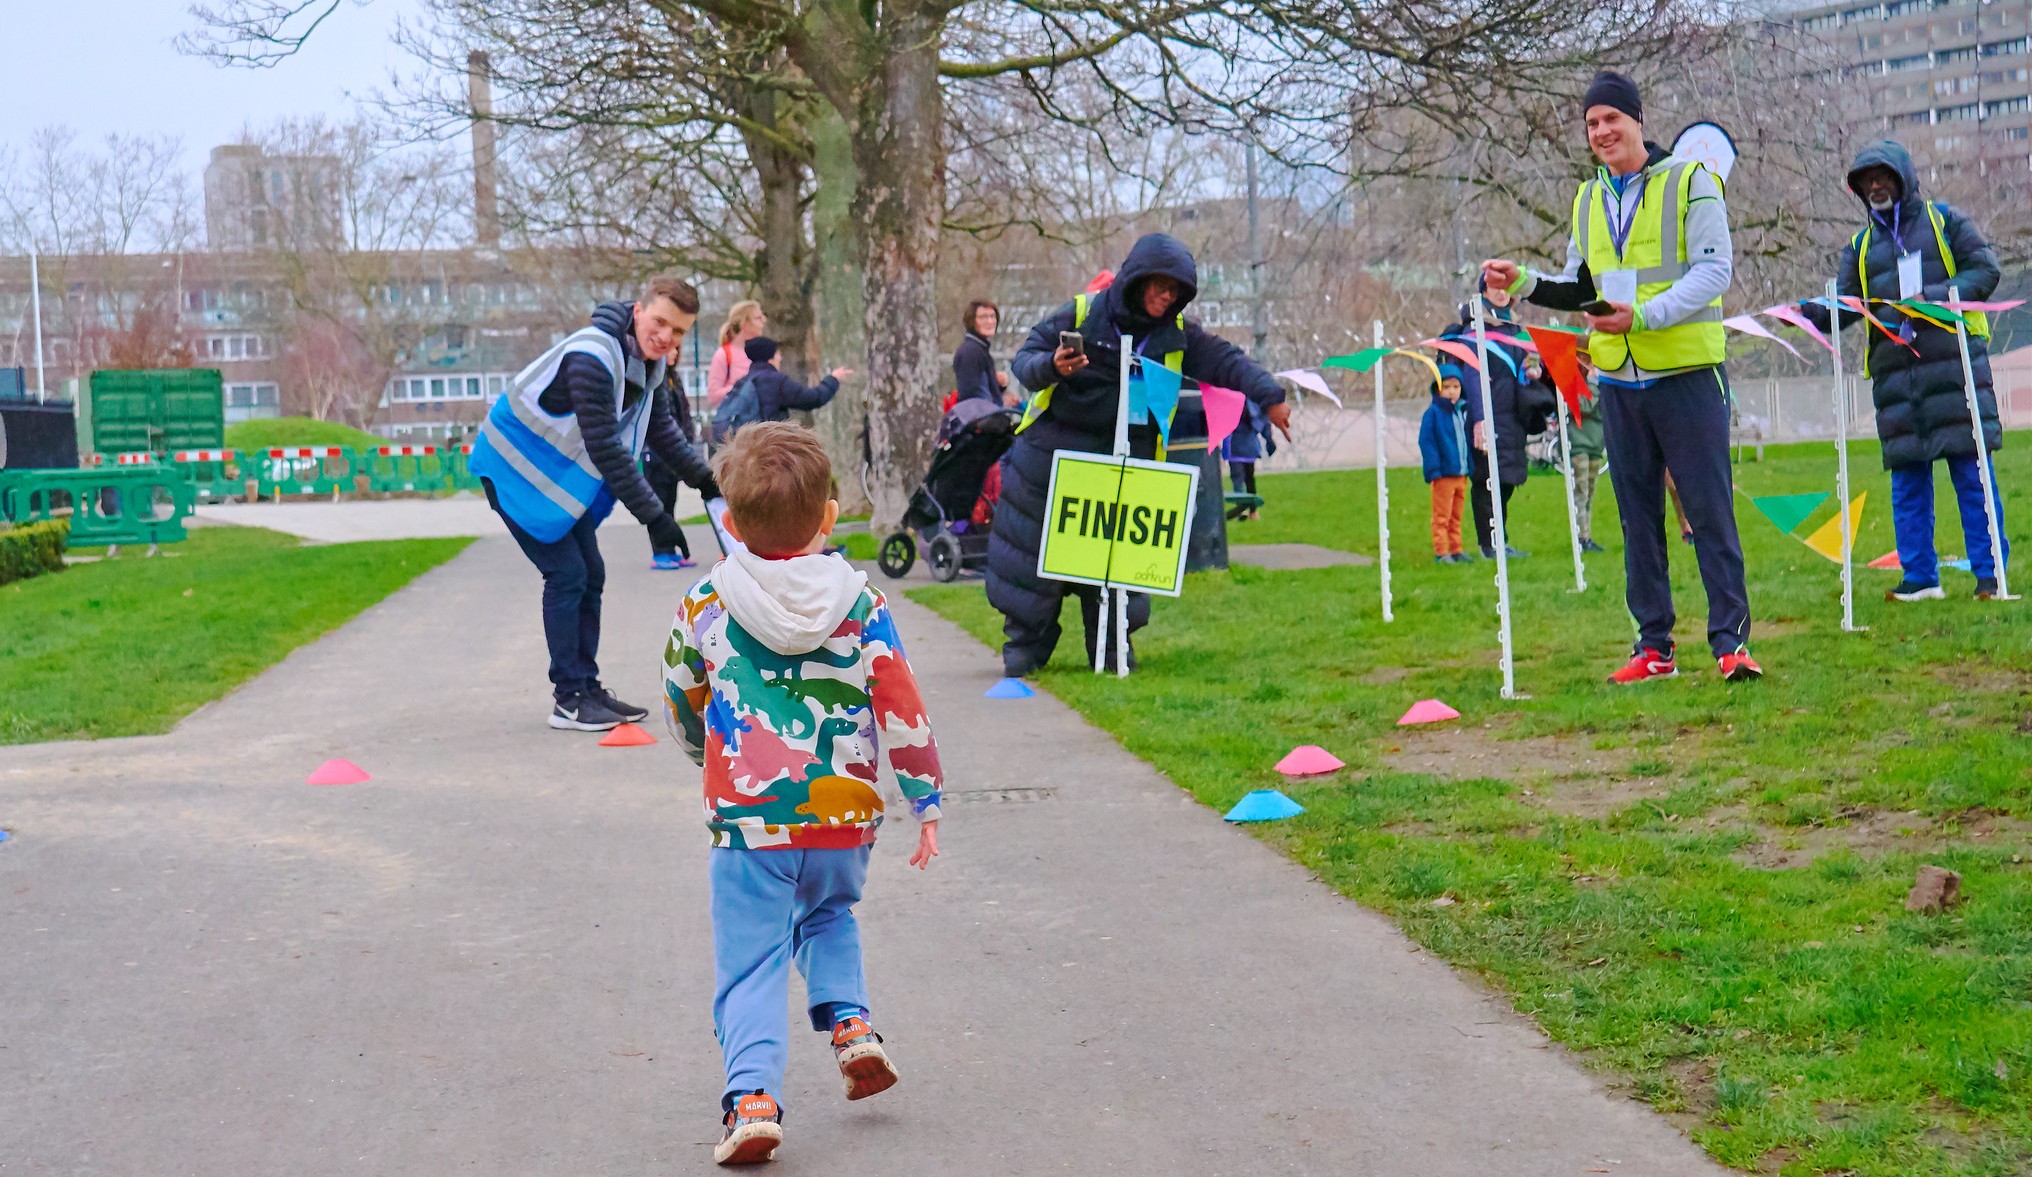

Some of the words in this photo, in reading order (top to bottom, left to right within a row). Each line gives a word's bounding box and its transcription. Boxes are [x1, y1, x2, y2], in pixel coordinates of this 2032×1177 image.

[1058, 496, 1177, 549] FINISH
[1134, 566, 1172, 584] parkrun
[745, 1101, 772, 1111] MARVEL
